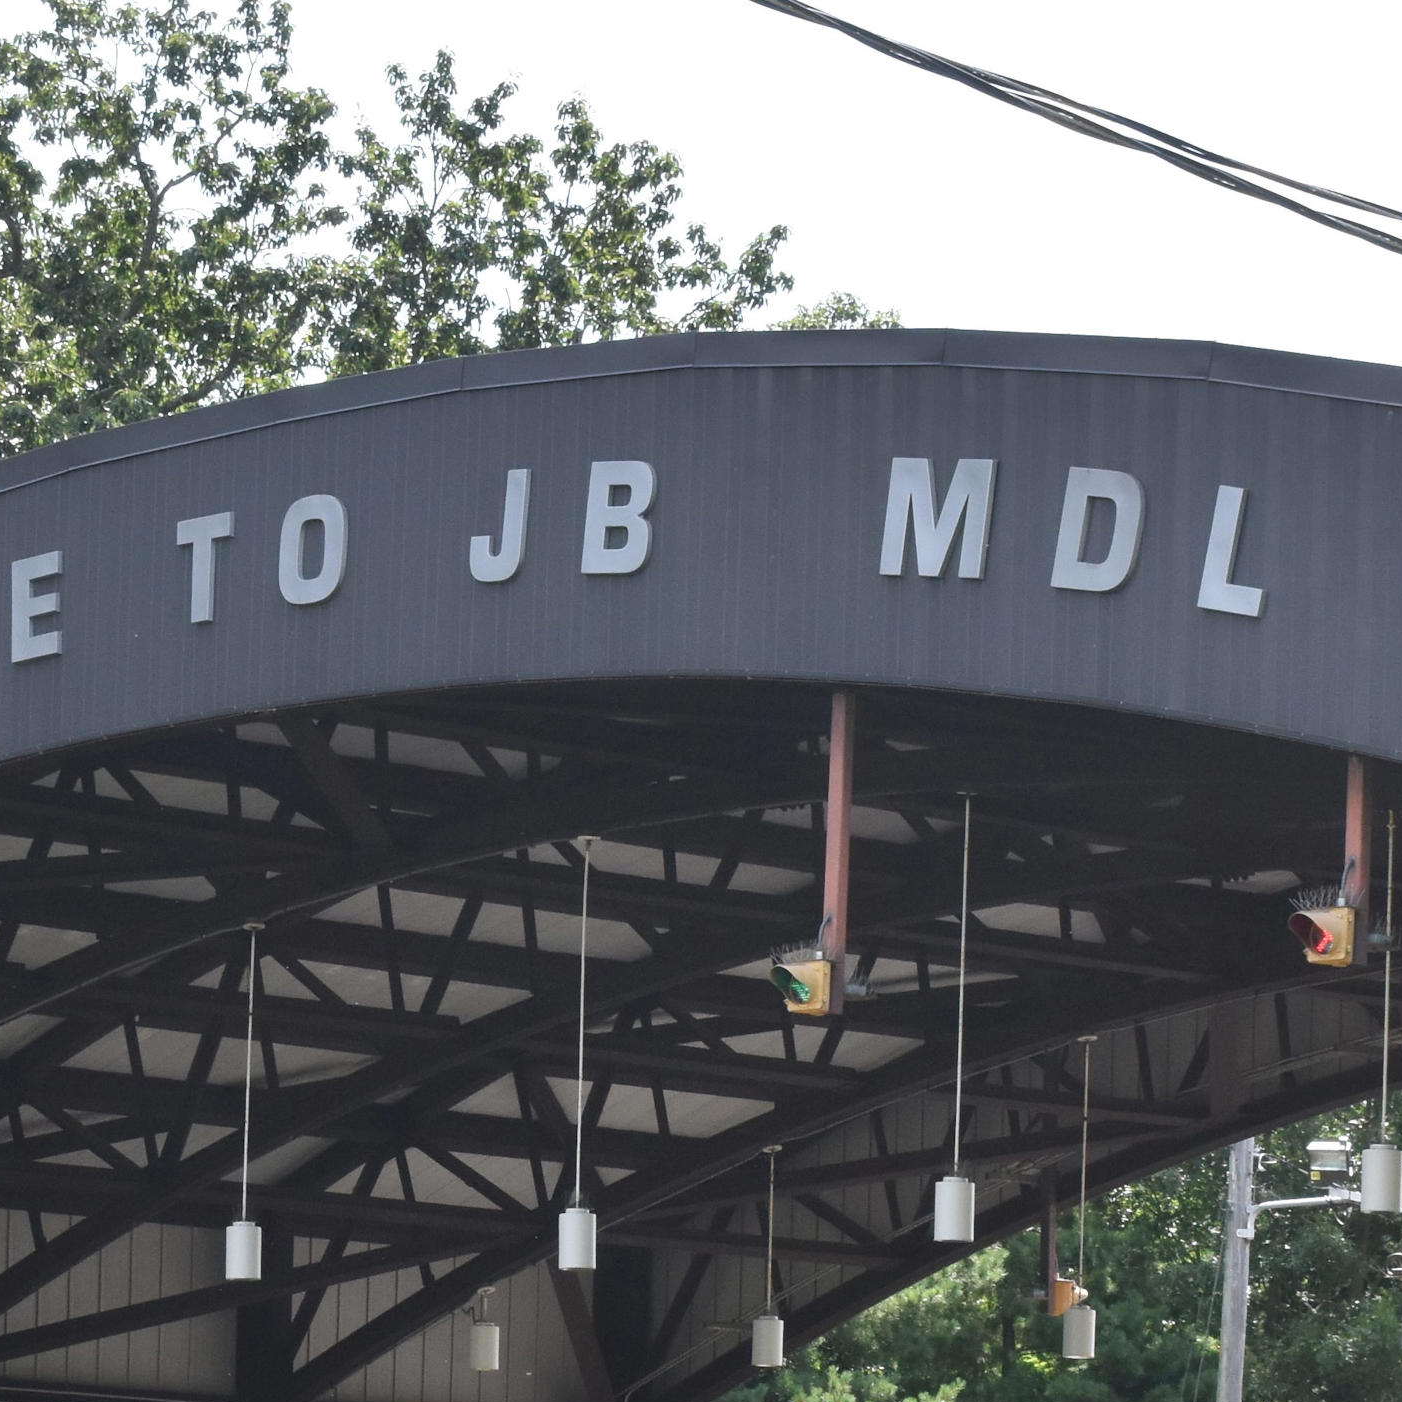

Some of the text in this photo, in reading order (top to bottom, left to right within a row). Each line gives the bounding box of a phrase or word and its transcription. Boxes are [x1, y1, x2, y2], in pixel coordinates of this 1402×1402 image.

[176, 494, 349, 623] TO
[469, 460, 658, 582] JB
[879, 457, 1267, 617] MDL
